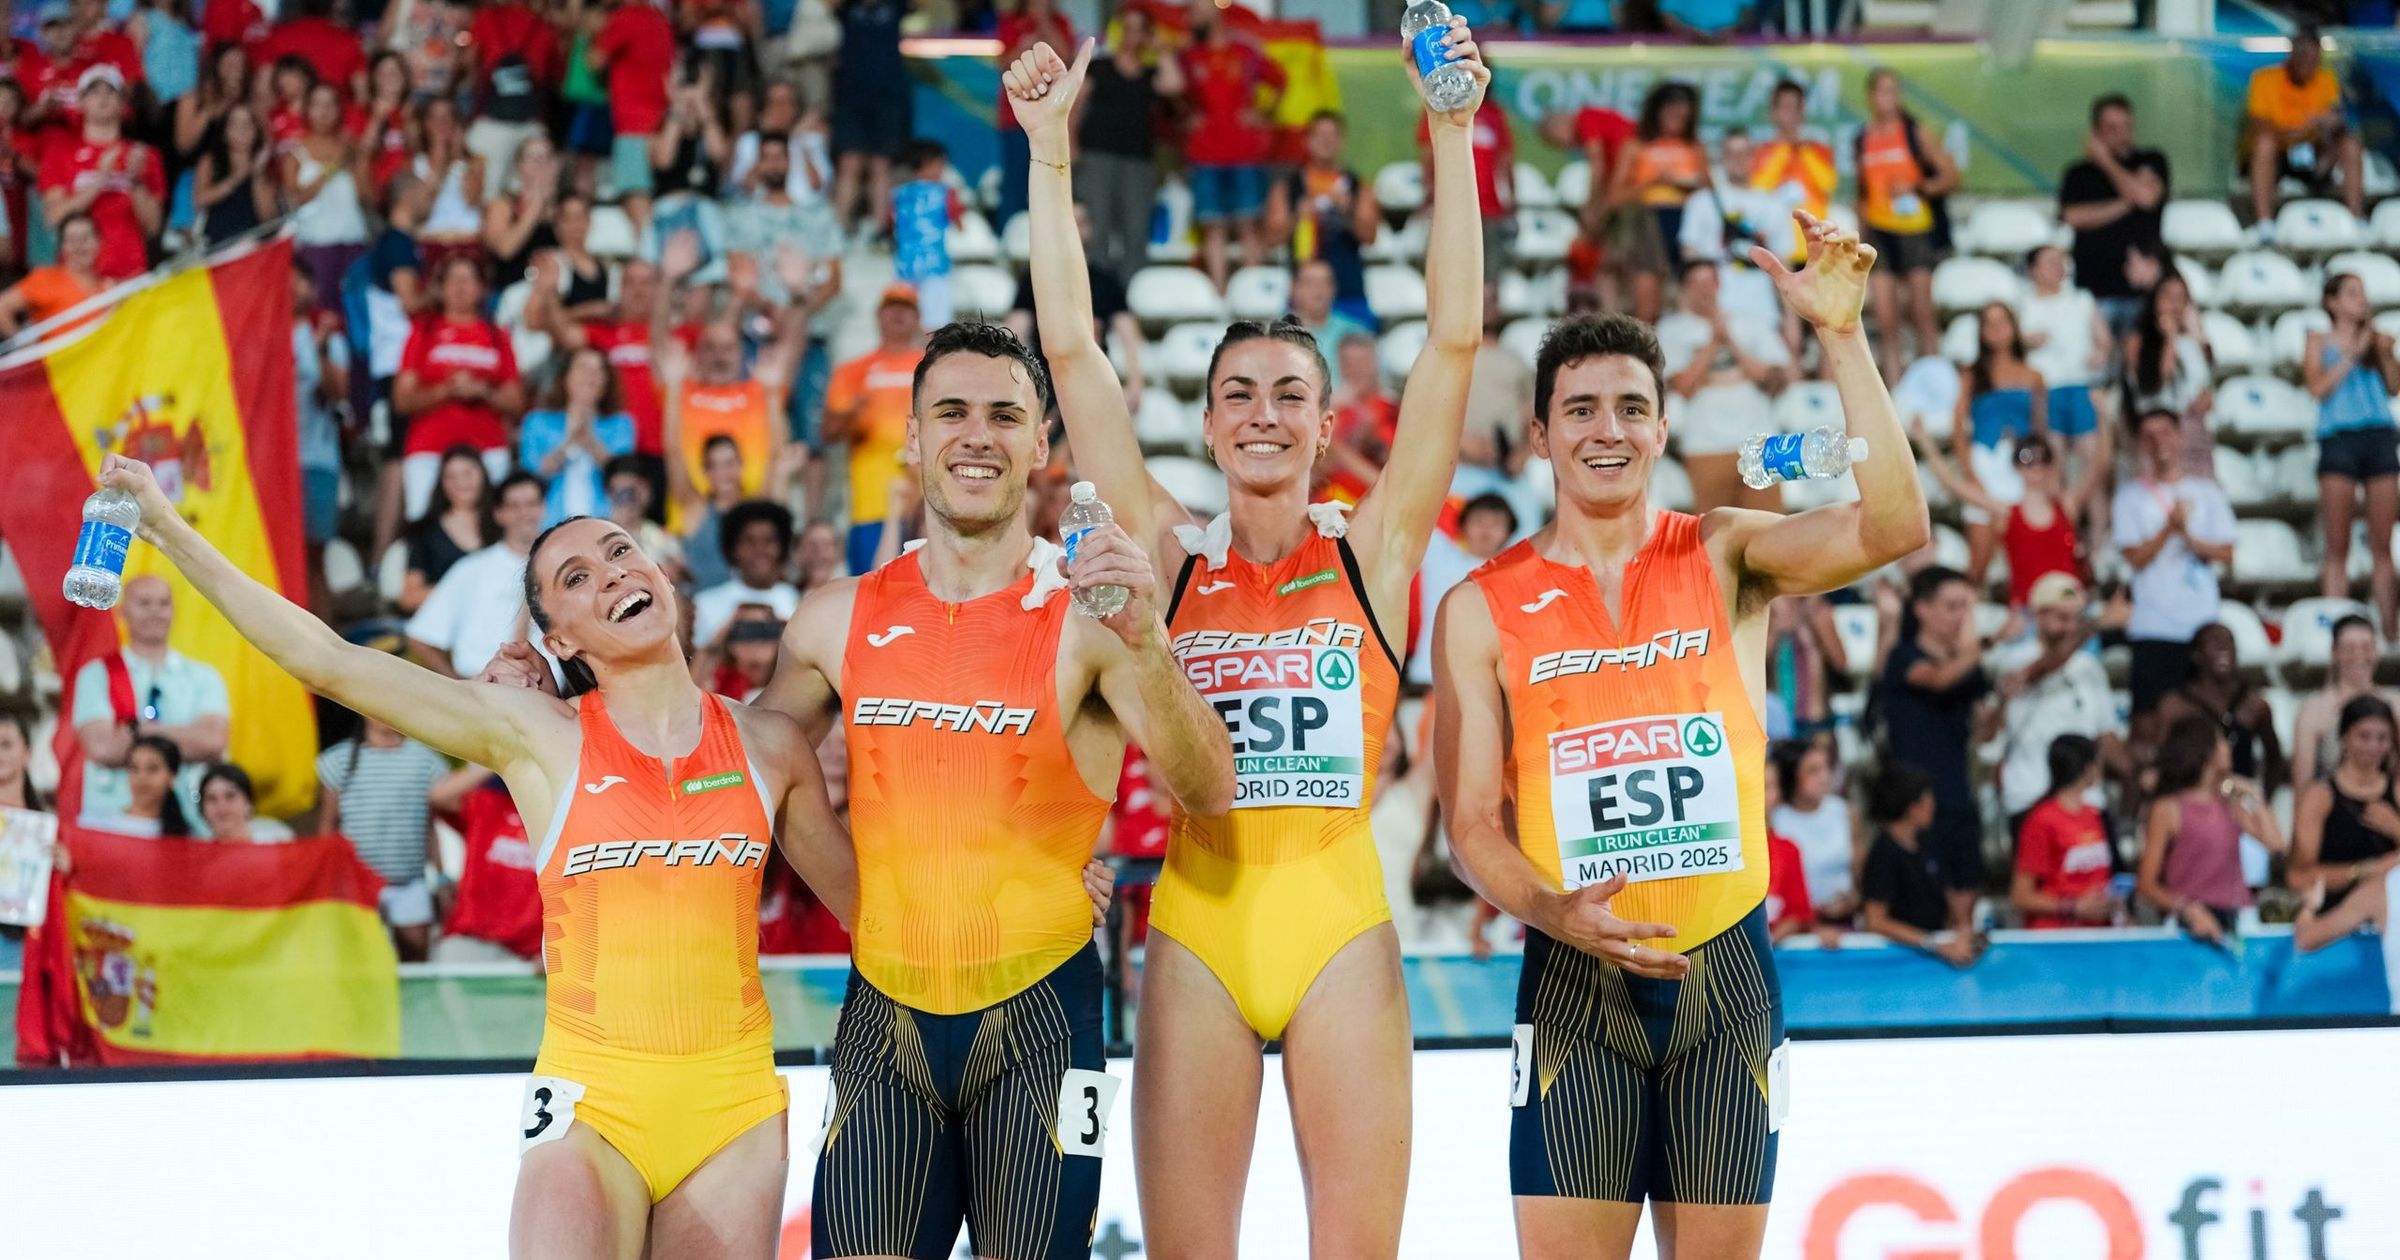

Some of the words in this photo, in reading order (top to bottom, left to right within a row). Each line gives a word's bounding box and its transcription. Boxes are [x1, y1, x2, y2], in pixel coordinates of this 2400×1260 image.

[1188, 655, 1309, 690] SPAR
[1529, 628, 1711, 685] ESPAÑA
[853, 697, 1037, 735] ESPAÑA
[1213, 696, 1329, 753] ESP
[1235, 759, 1259, 772] UN
[1558, 725, 1680, 769] SPAR
[703, 774, 742, 789] Iberdrola
[1235, 780, 1289, 800] DRID
[1296, 780, 1350, 799] 2025
[1588, 766, 1704, 832] ESP
[563, 833, 769, 877] ESPAÑA
[1606, 834, 1642, 851] RUN
[1579, 852, 1674, 881] MADRID
[1680, 846, 1729, 869] 2025
[524, 1087, 553, 1139] 3
[1081, 1086, 1100, 1145] 3
